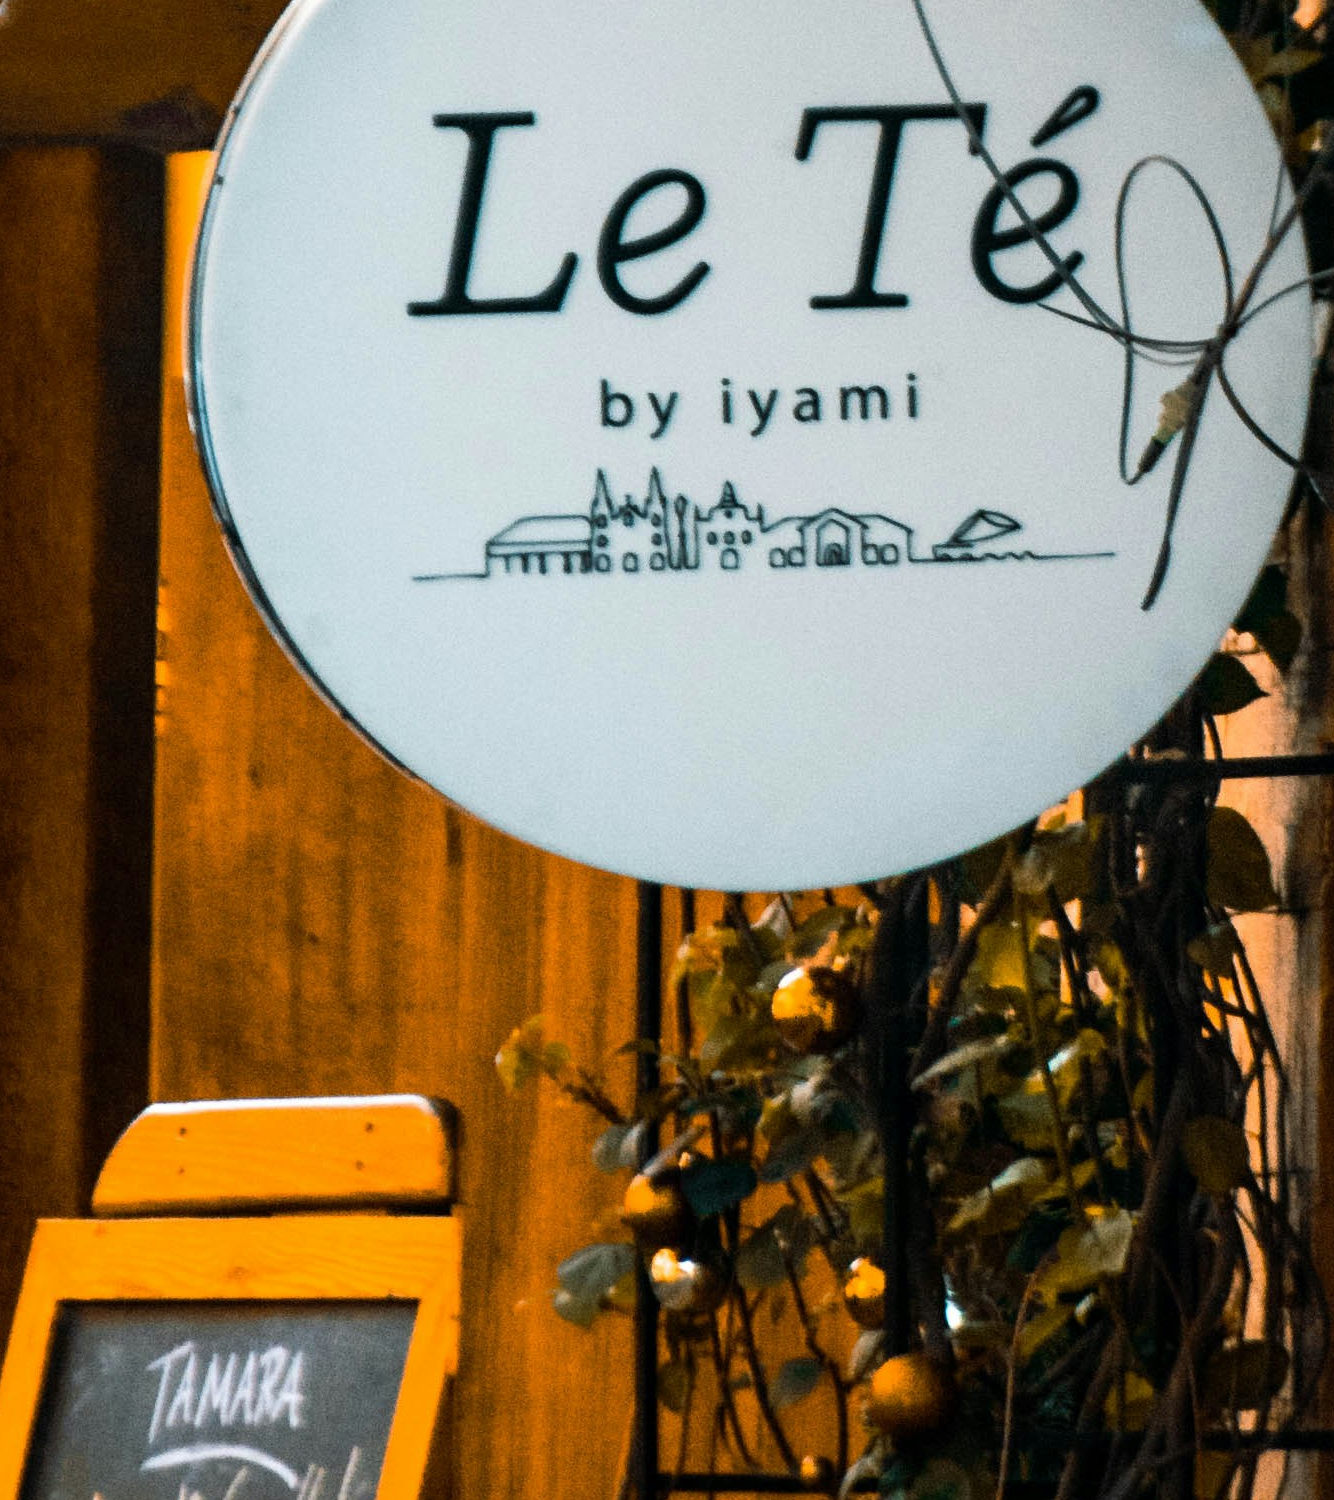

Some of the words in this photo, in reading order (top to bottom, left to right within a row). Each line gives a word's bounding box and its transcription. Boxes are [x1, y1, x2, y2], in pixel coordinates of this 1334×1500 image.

[407, 112, 708, 318] Le
[792, 85, 1102, 310] Té
[601, 379, 679, 438] by
[722, 374, 920, 431] iyami
[146, 1341, 305, 1443] TAMARA
